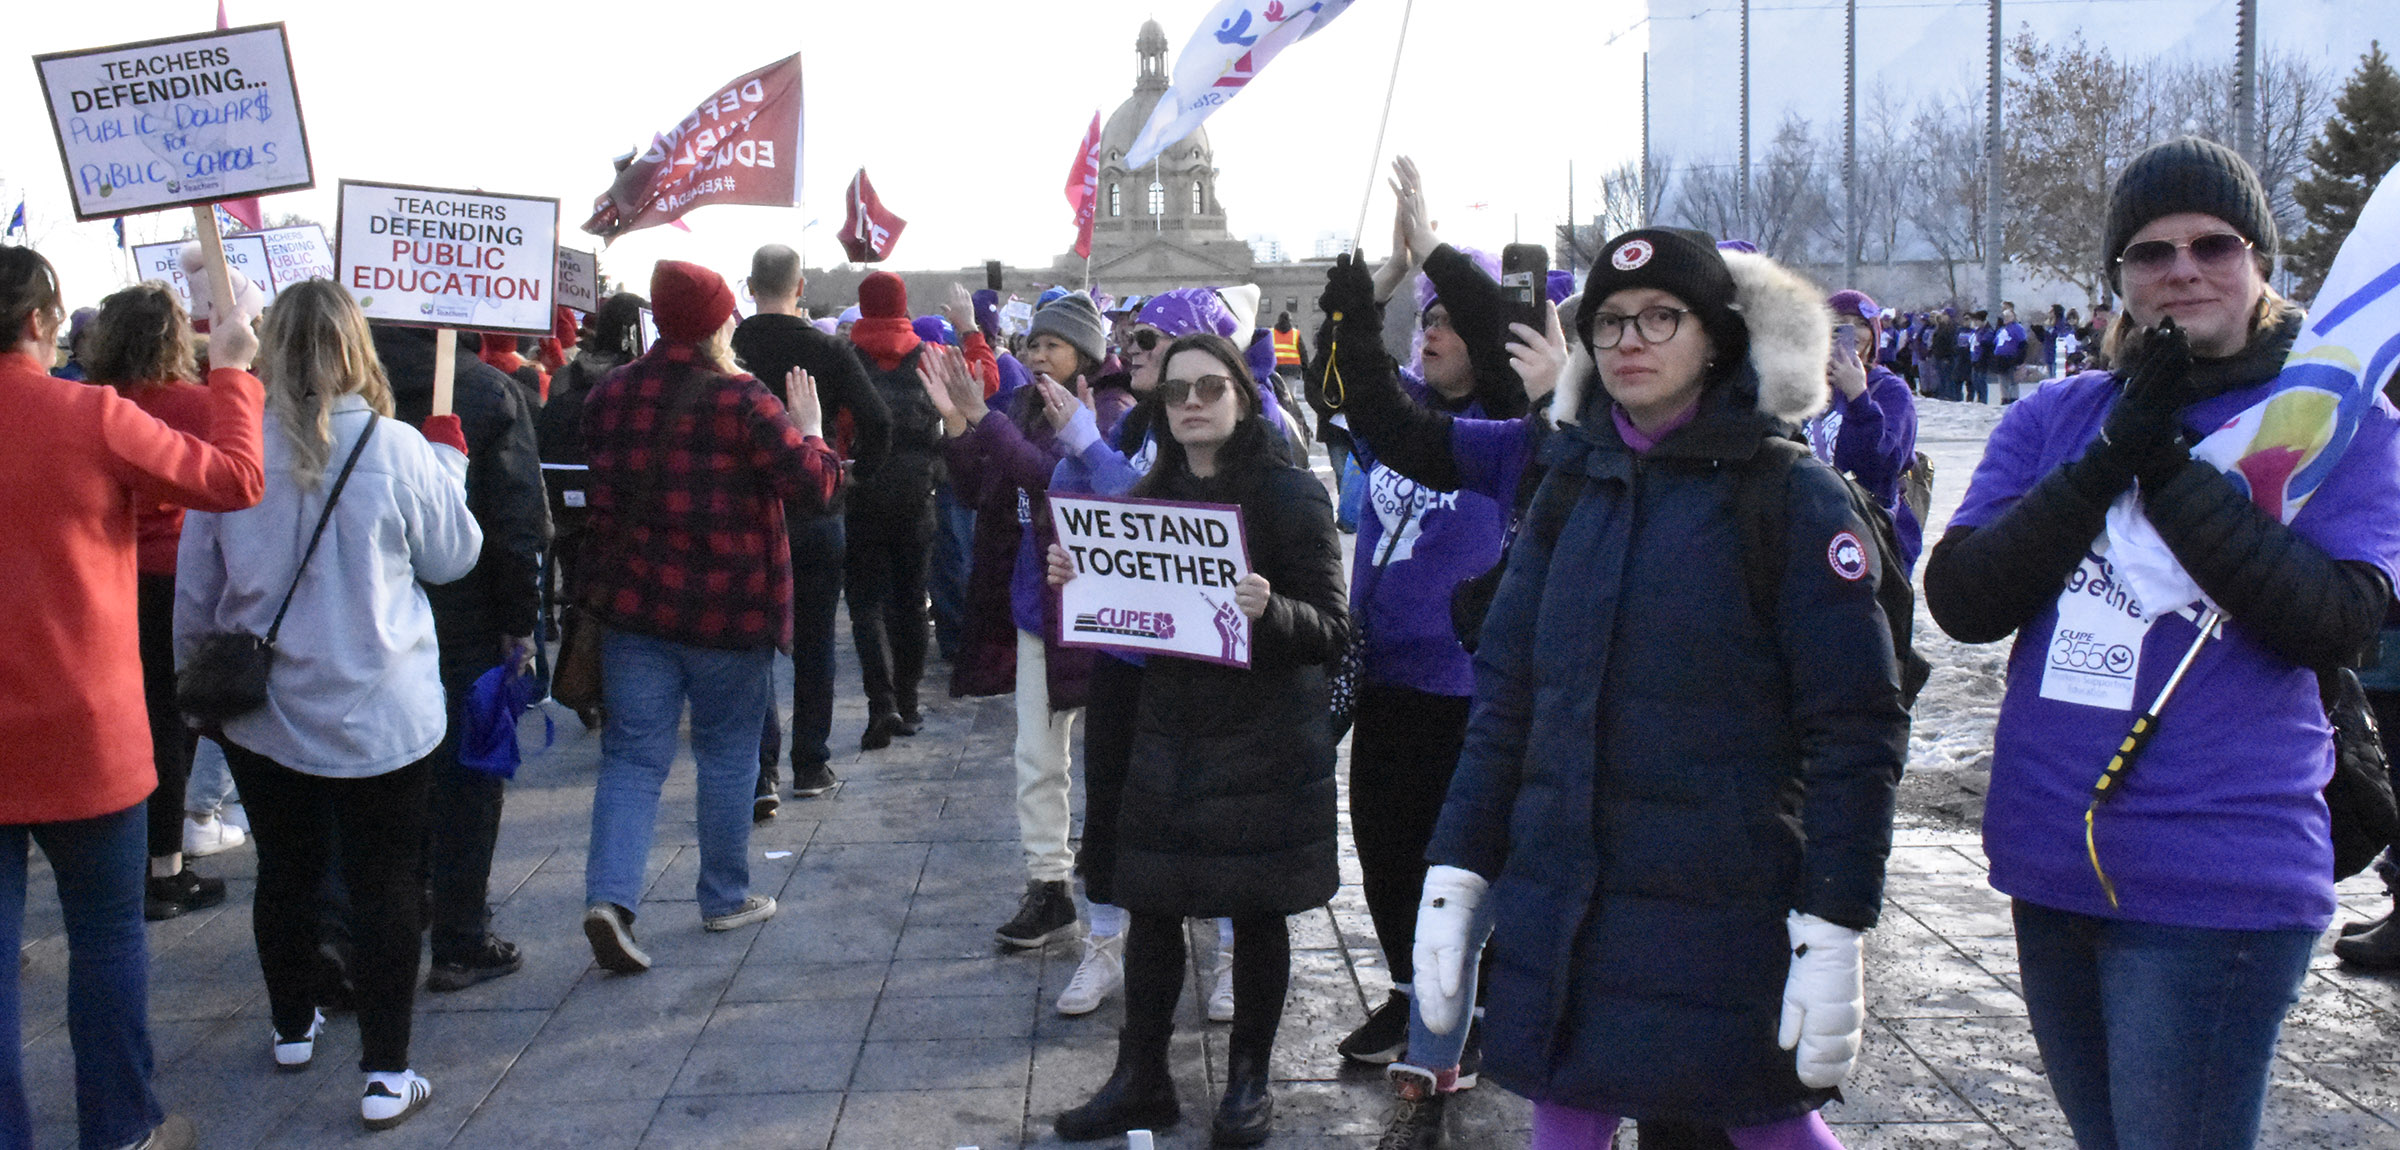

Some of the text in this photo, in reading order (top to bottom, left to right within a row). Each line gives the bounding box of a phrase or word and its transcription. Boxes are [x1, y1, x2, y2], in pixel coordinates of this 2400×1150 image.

[101, 47, 230, 81] TEACHERS
[70, 68, 267, 113] DEFENDING...
[69, 113, 155, 144] PUBLIC
[183, 141, 277, 179] SCHOOLS
[394, 197, 507, 221] TEACHERS
[370, 215, 523, 246] DEFENDING
[271, 252, 313, 269] UBLIC
[392, 239, 505, 270] PUBLIC
[274, 264, 333, 284] UCATION
[353, 266, 540, 301] EDUCATION
[1060, 506, 1229, 548] WE STAND
[1069, 545, 1238, 588] TOGETHER
[1097, 607, 1152, 630] CUPE
[2060, 629, 2095, 641] CUPE
